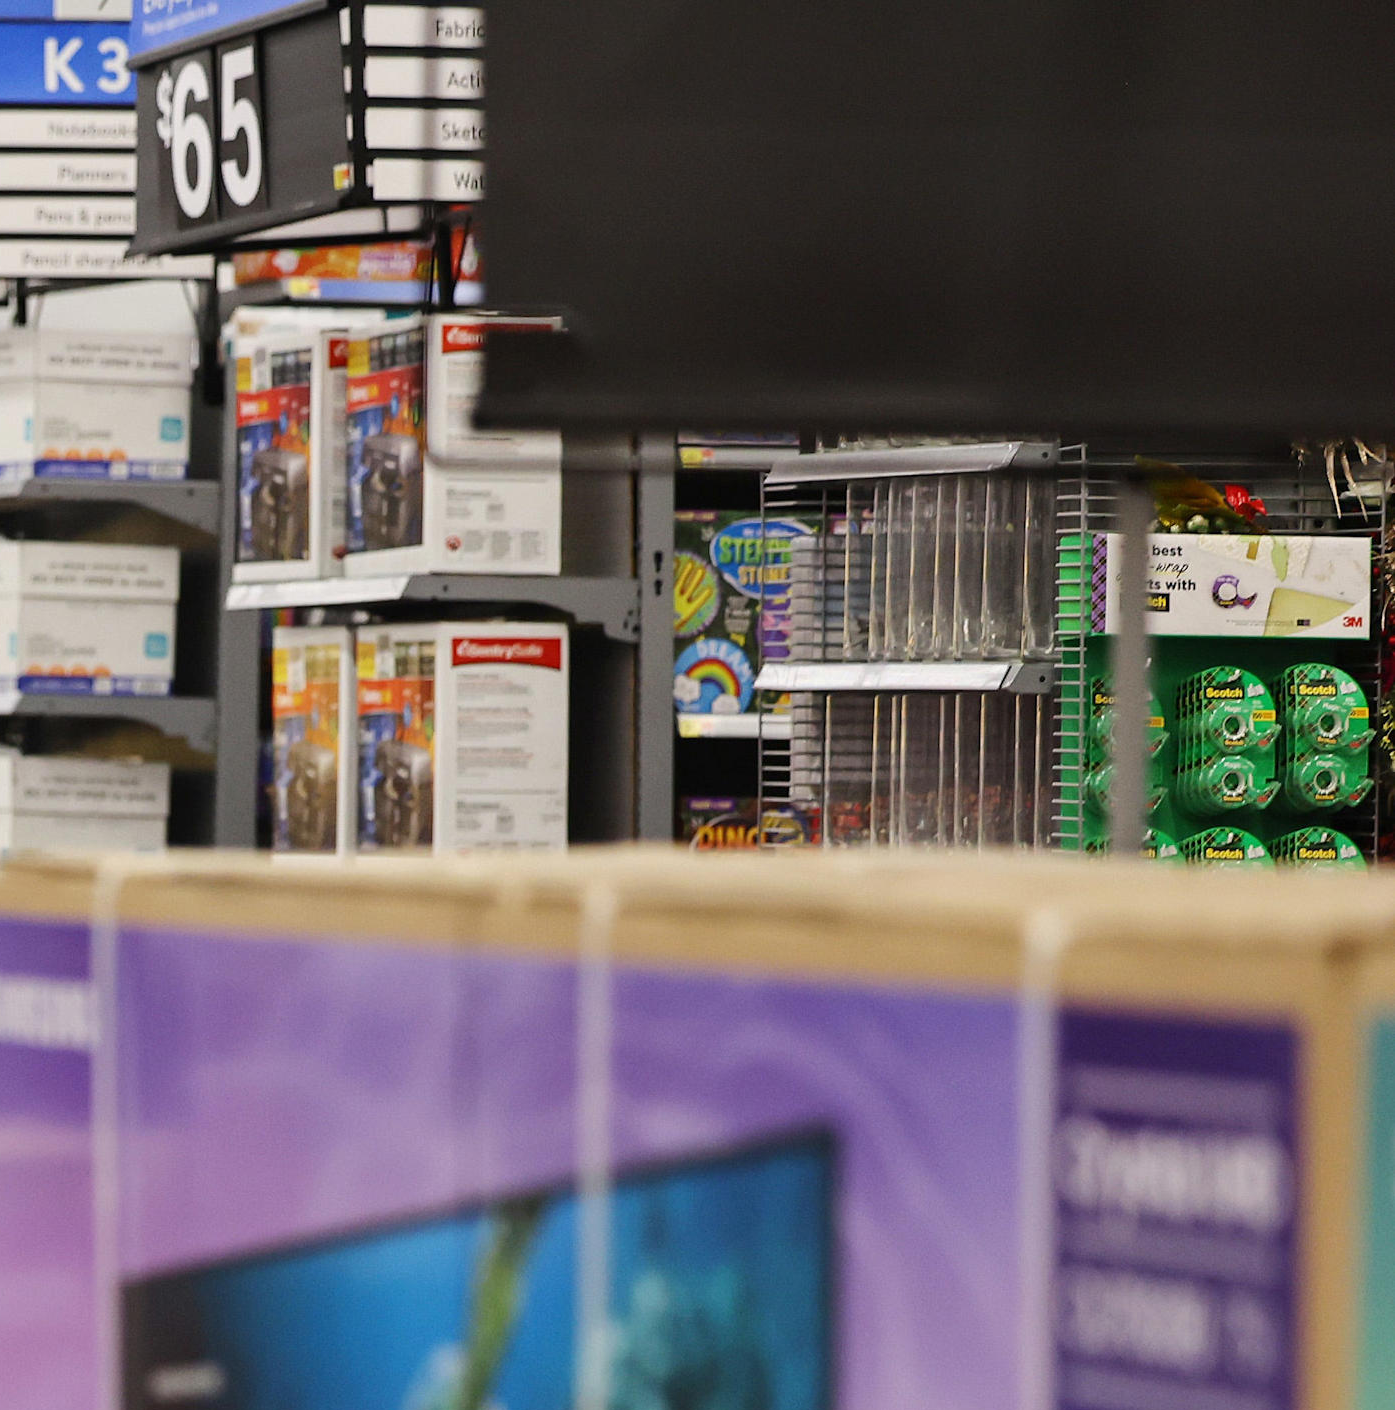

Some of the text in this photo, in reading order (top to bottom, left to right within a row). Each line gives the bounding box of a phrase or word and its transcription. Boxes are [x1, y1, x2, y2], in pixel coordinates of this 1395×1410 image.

[1152, 545, 1183, 557] best
[1165, 579, 1197, 591] with
[1342, 616, 1363, 628] 3M
[1205, 686, 1244, 699] Scotch
[1298, 683, 1337, 696] Scotch
[1205, 847, 1244, 860] Scotch
[1298, 847, 1337, 860] Scotch
